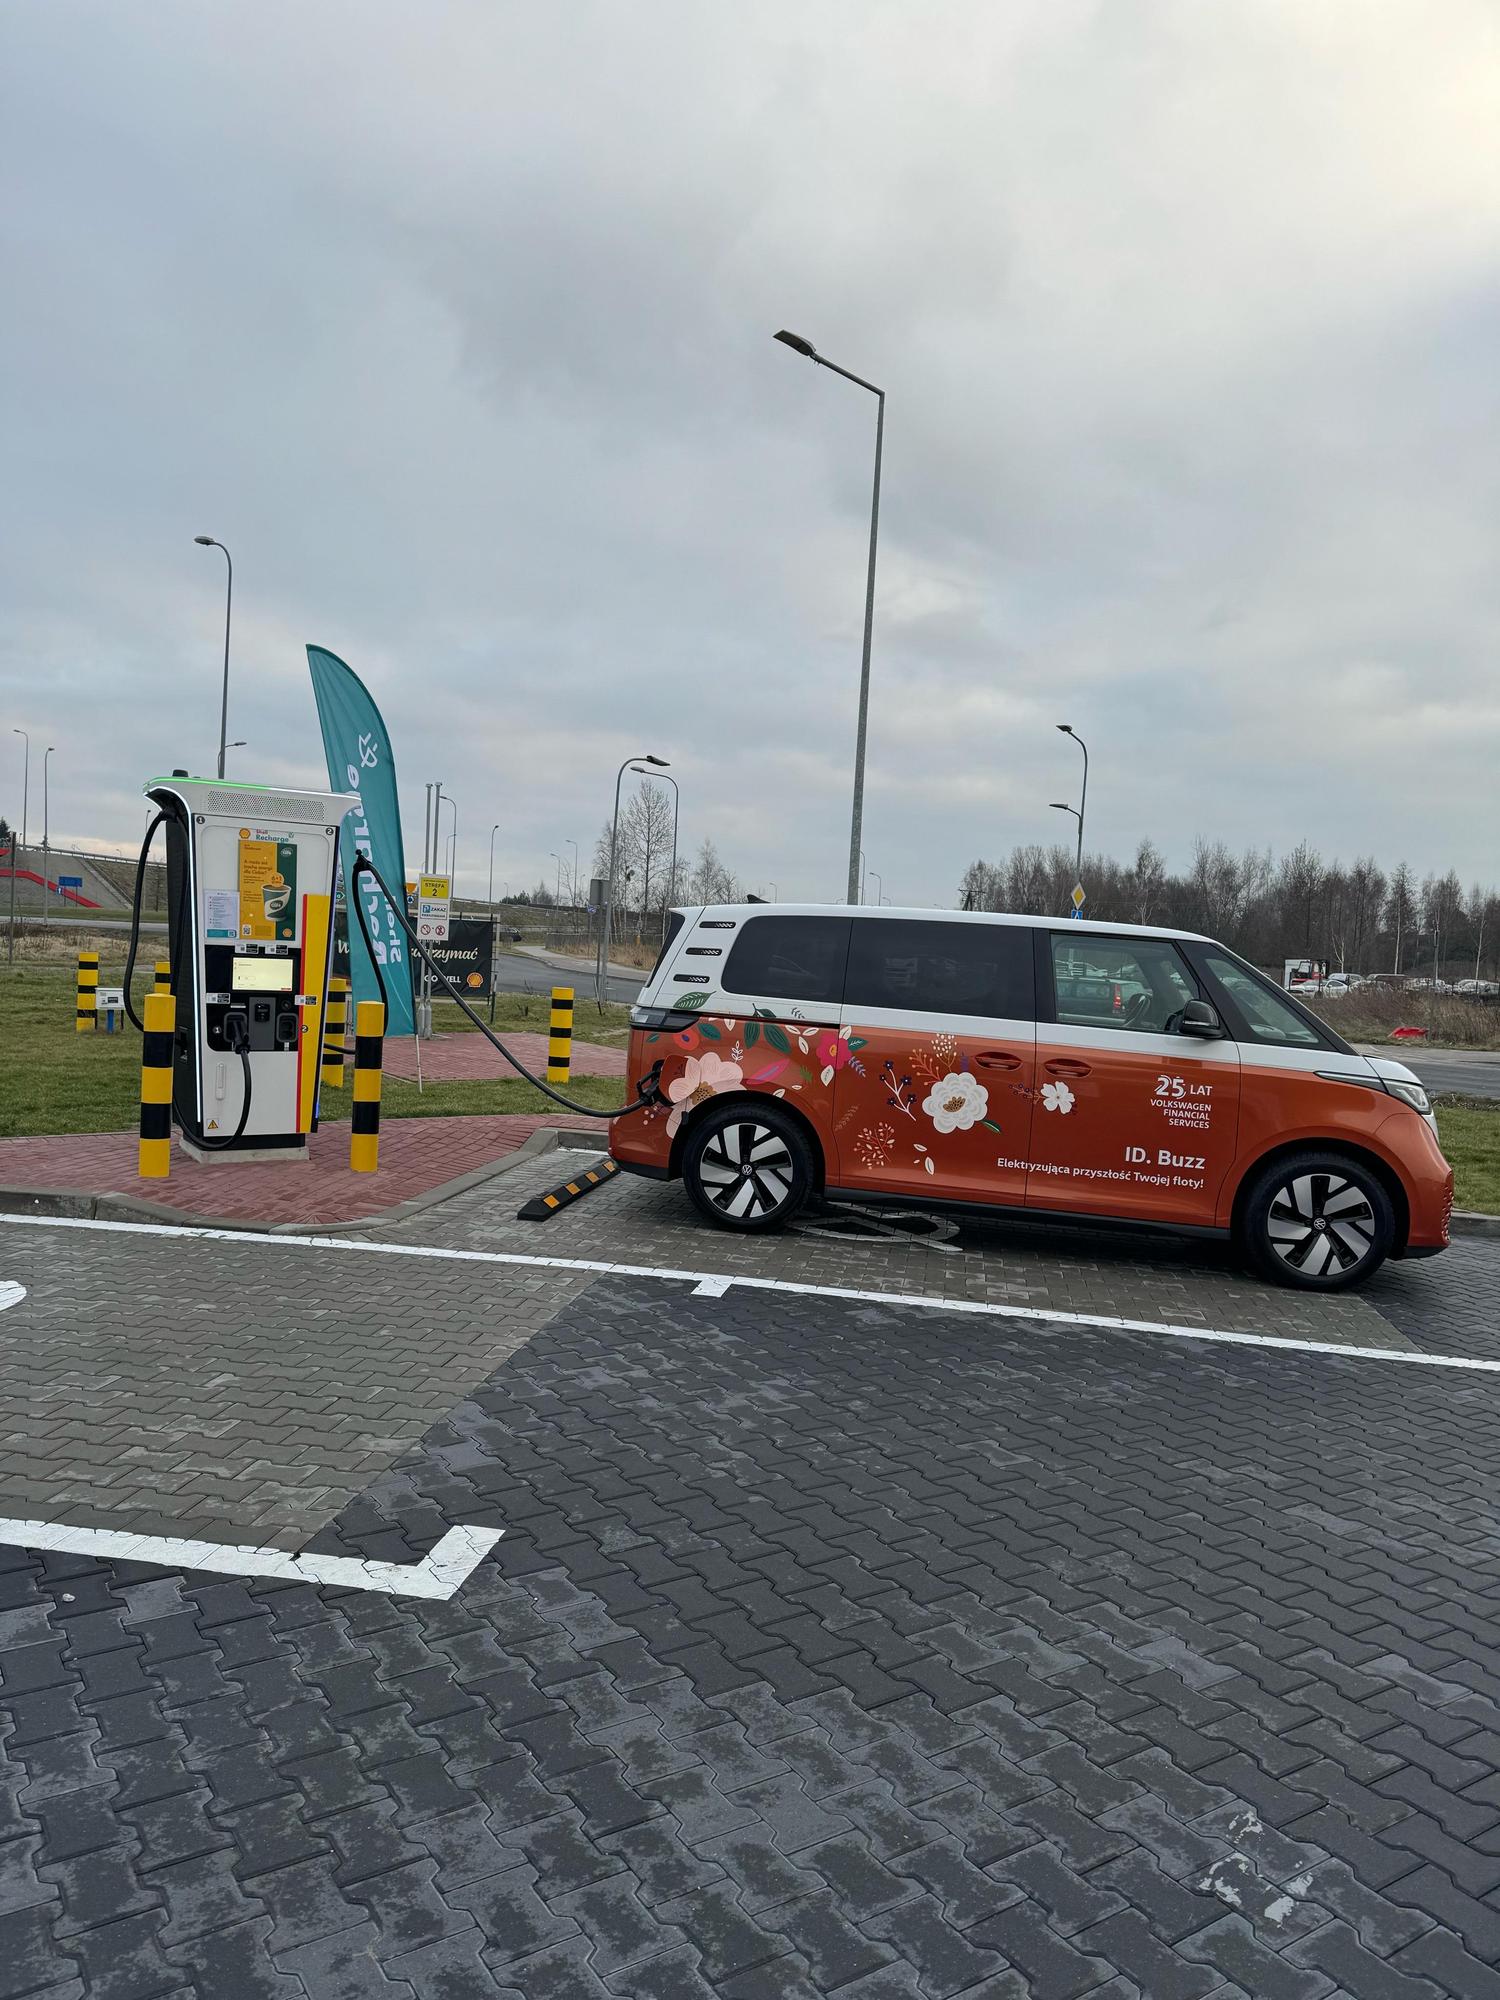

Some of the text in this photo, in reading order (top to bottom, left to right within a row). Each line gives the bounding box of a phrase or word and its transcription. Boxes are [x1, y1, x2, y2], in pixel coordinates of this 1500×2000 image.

[255, 835, 289, 843] Recharge
[432, 888, 438, 897] 2
[1154, 1075, 1213, 1099] 25 LAT
[1150, 1099, 1212, 1112] VOLKSWAGEN
[1163, 1108, 1210, 1120] FINANCIAL
[1169, 1118, 1210, 1129] SERVICES
[1125, 1146, 1205, 1170] ID. Buzz
[997, 1157, 1204, 1189] Elektryzująca przyszłość Twojej floty!
